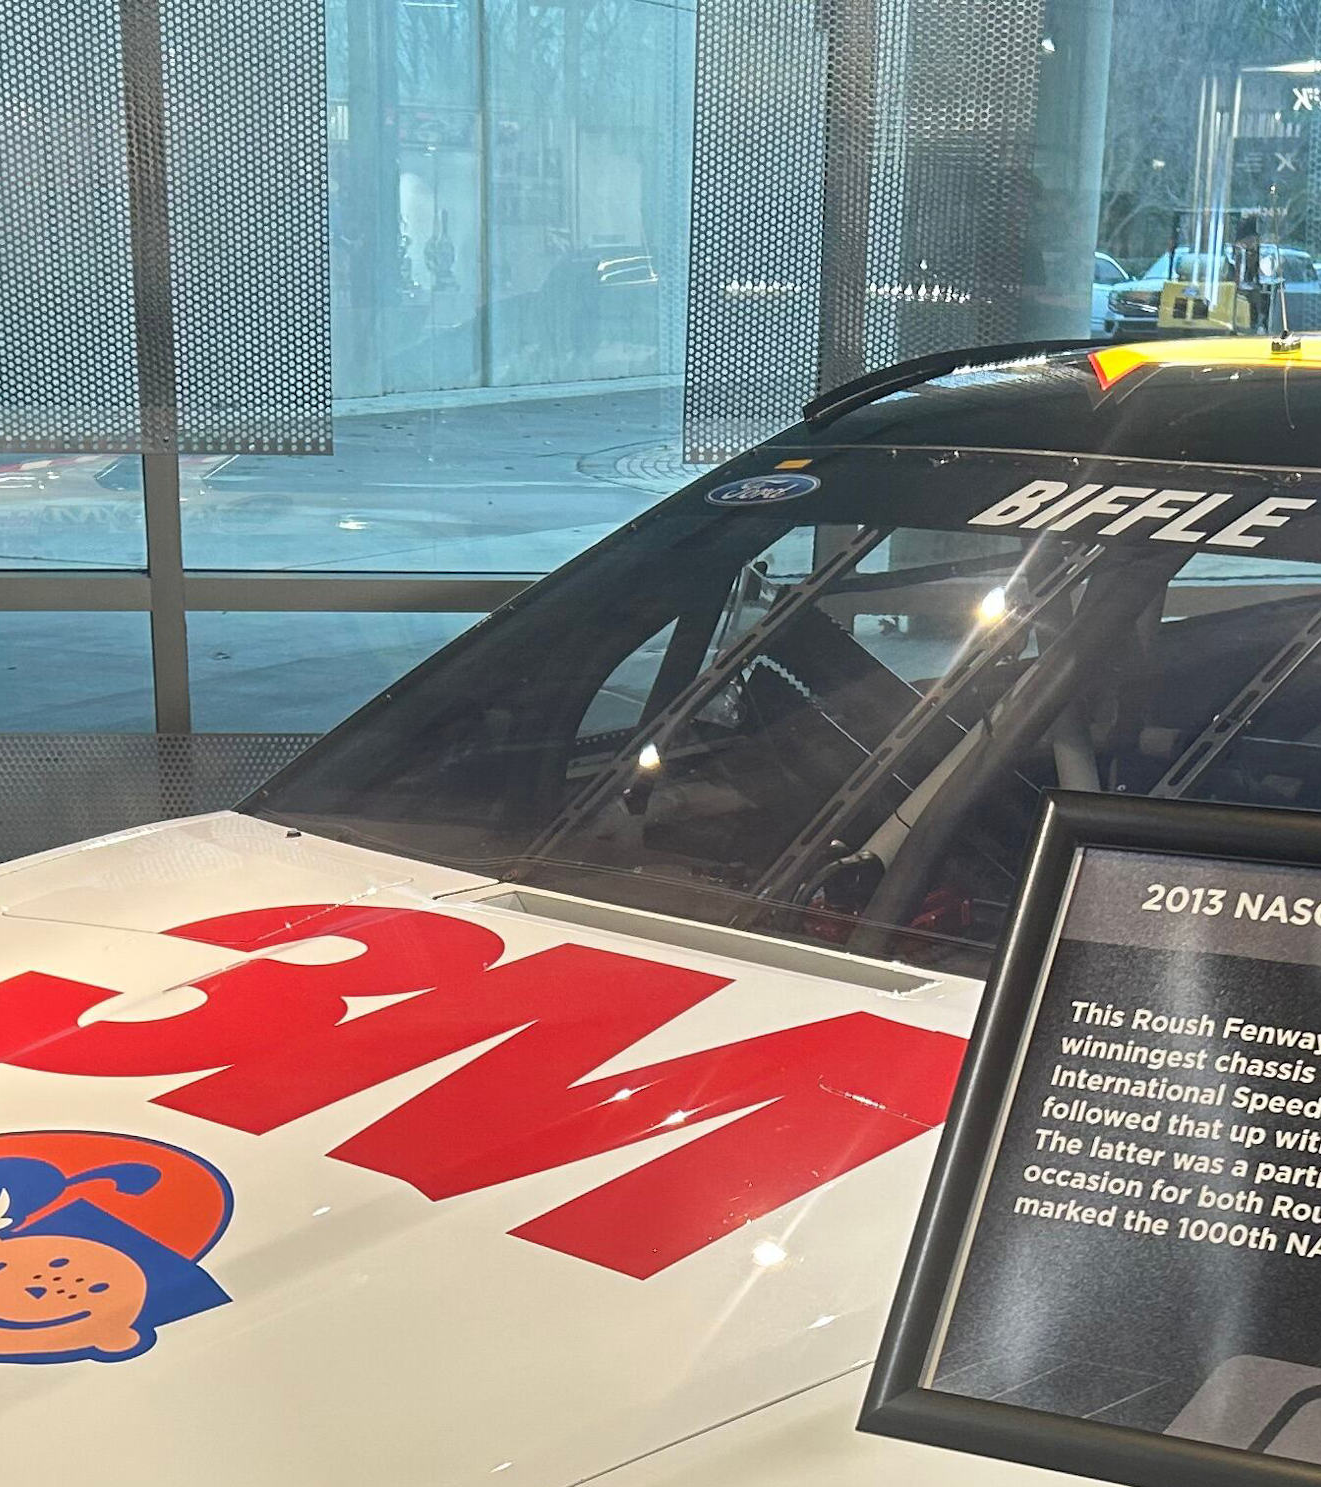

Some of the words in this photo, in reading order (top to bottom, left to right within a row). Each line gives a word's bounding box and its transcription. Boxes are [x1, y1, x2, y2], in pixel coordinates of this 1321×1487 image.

[968, 480, 1317, 548] BIFFLE
[1141, 884, 1226, 915] 2013
[1071, 1000, 1124, 1027] This
[1131, 1008, 1214, 1036] Roush
[1061, 1034, 1207, 1069] winningest
[1214, 1051, 1318, 1083] chassis
[1050, 1064, 1226, 1105] International
[1041, 1095, 1161, 1132] followed
[1167, 1114, 1223, 1139] that
[1229, 1124, 1265, 1147] up
[1035, 1128, 1082, 1154] The
[1089, 1135, 1165, 1166] latter
[1173, 1152, 1224, 1174] was
[1231, 1159, 1248, 1177] a
[1023, 1164, 1142, 1197] occasion
[1149, 1178, 1192, 1204] for
[1197, 1184, 1263, 1214] both
[1013, 1196, 1117, 1227] marked
[1123, 1210, 1168, 1235] the
[1178, 1217, 1277, 1251] 1000th
